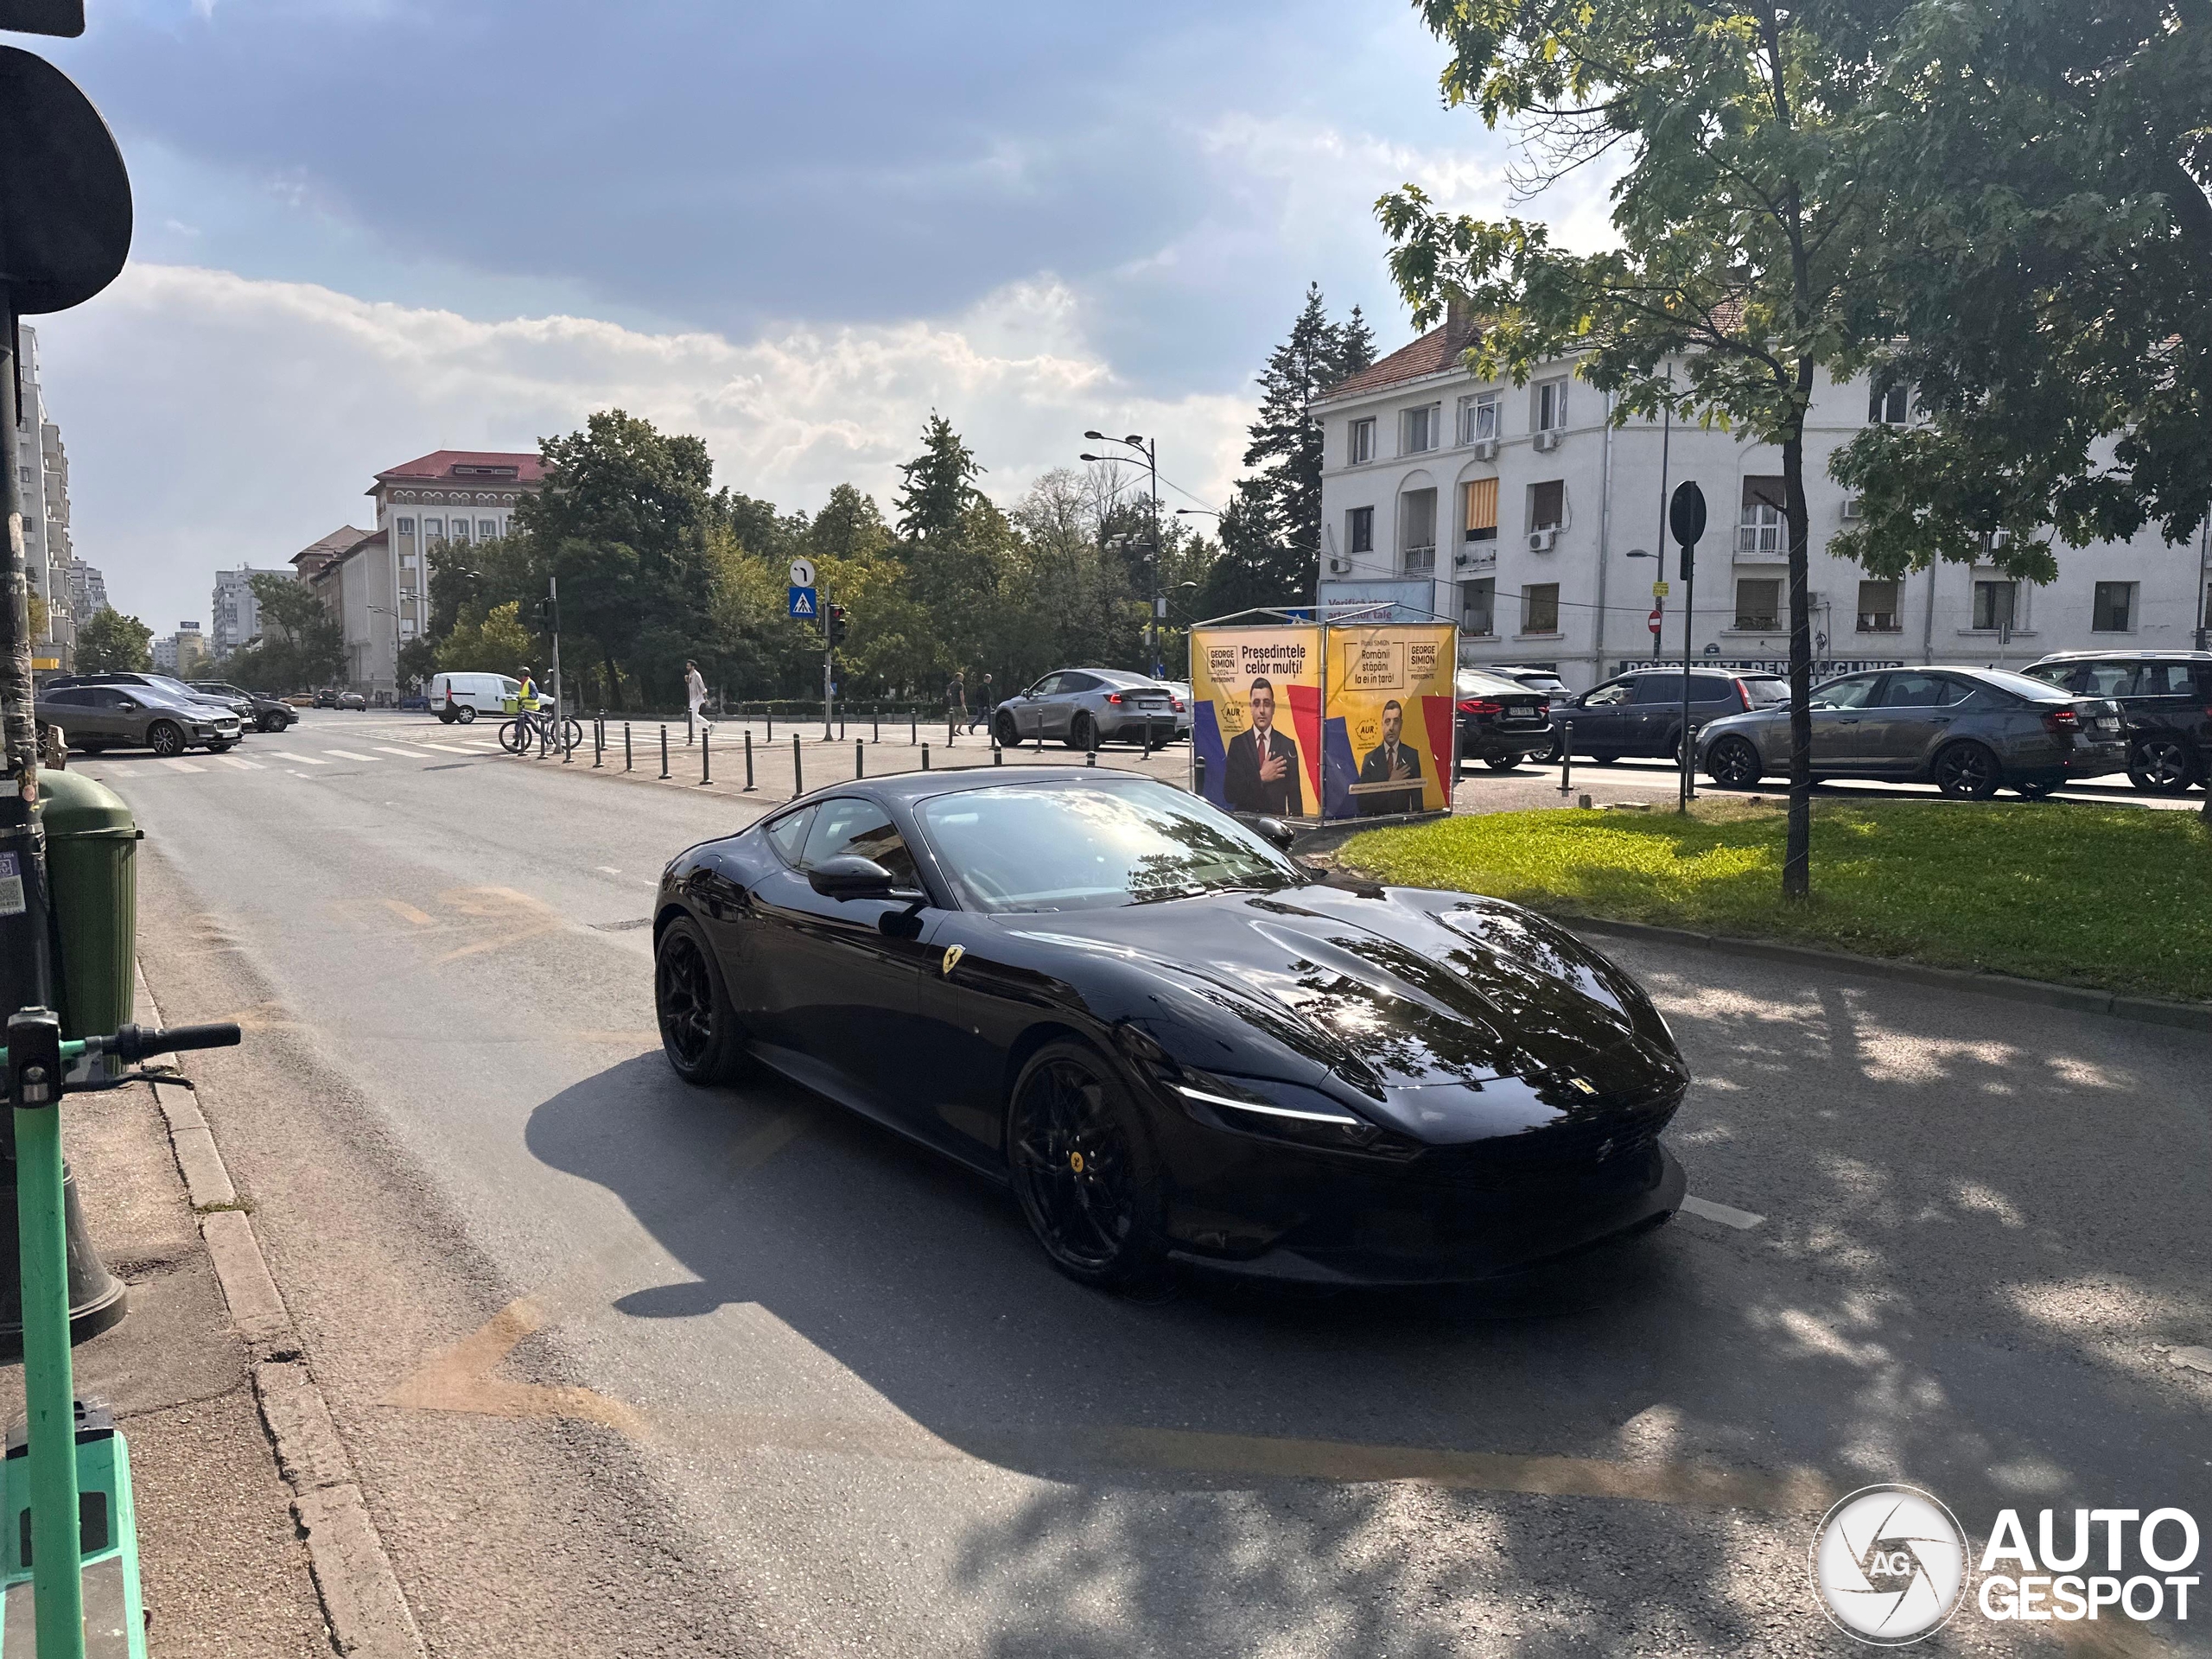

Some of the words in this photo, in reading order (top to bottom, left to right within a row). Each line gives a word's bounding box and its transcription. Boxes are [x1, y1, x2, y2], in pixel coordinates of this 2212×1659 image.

[1373, 609, 1392, 619] tale
[1211, 650, 1234, 658] GEORGE
[1242, 644, 1306, 663] Președintele
[1361, 649, 1390, 659] Românii
[1411, 645, 1435, 654] GEORGE
[1211, 659, 1235, 668] SIMION
[1411, 655, 1435, 664] SIMION
[1245, 660, 1270, 674] celor
[1273, 660, 1302, 678] mulți!
[1362, 661, 1389, 674] stăpâni
[1355, 674, 1362, 683] la
[1363, 674, 1369, 683] ei
[1226, 708, 1240, 716] AUR
